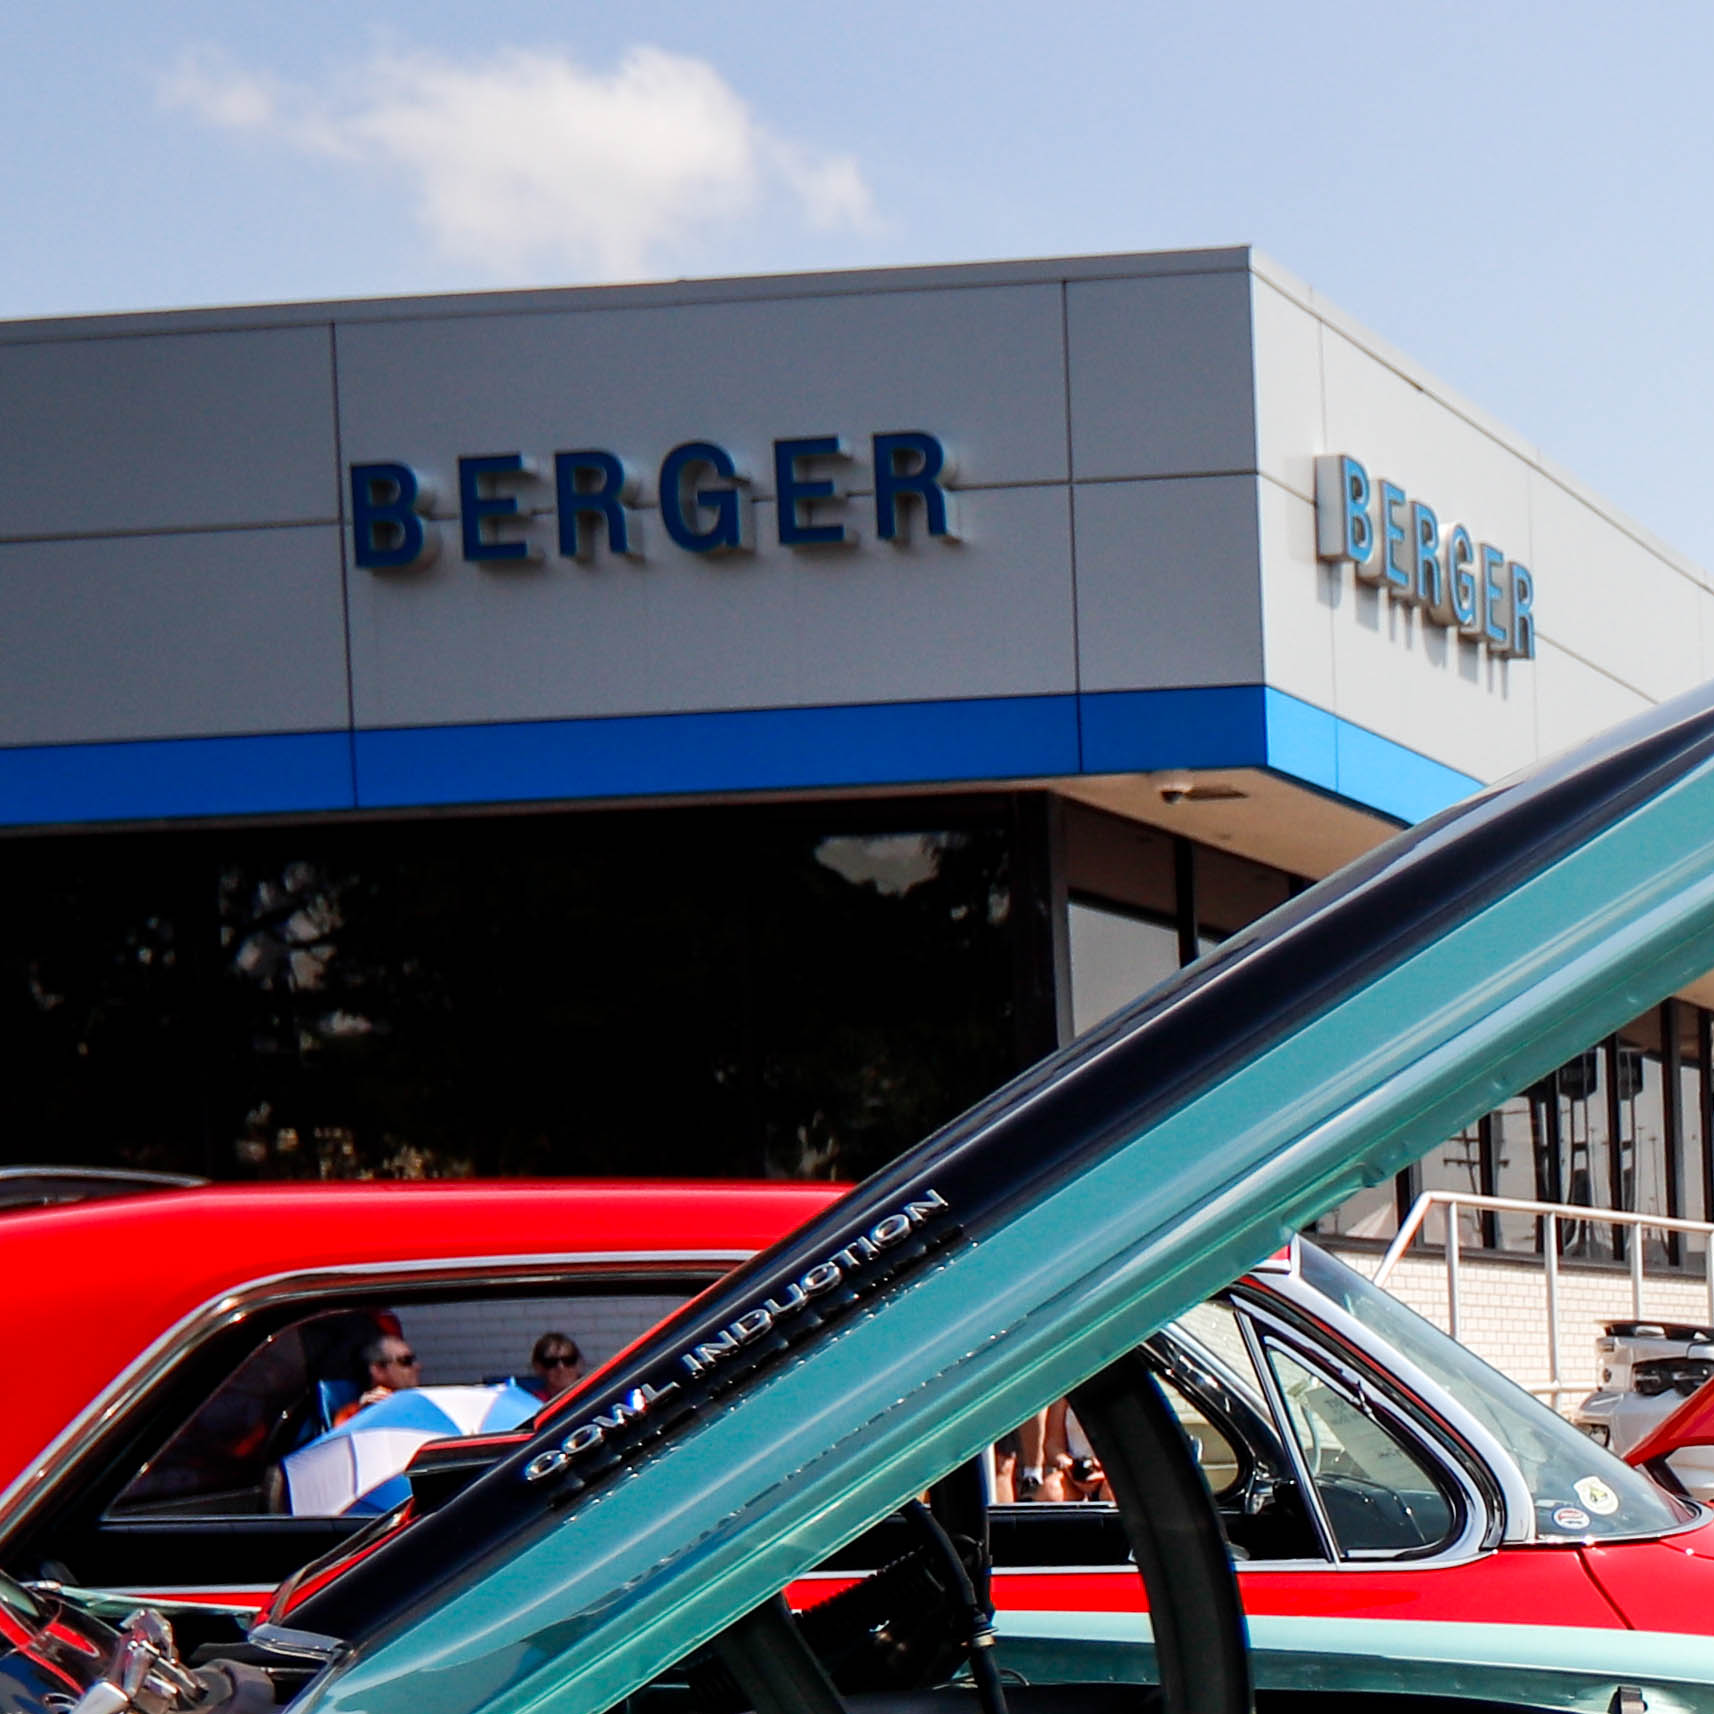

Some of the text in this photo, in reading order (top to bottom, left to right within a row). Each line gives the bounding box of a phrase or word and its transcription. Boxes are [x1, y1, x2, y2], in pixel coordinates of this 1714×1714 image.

[349, 431, 957, 570] BERGER
[1318, 455, 1536, 660] BERGER
[524, 1189, 949, 1482] COWL INDUCTION
